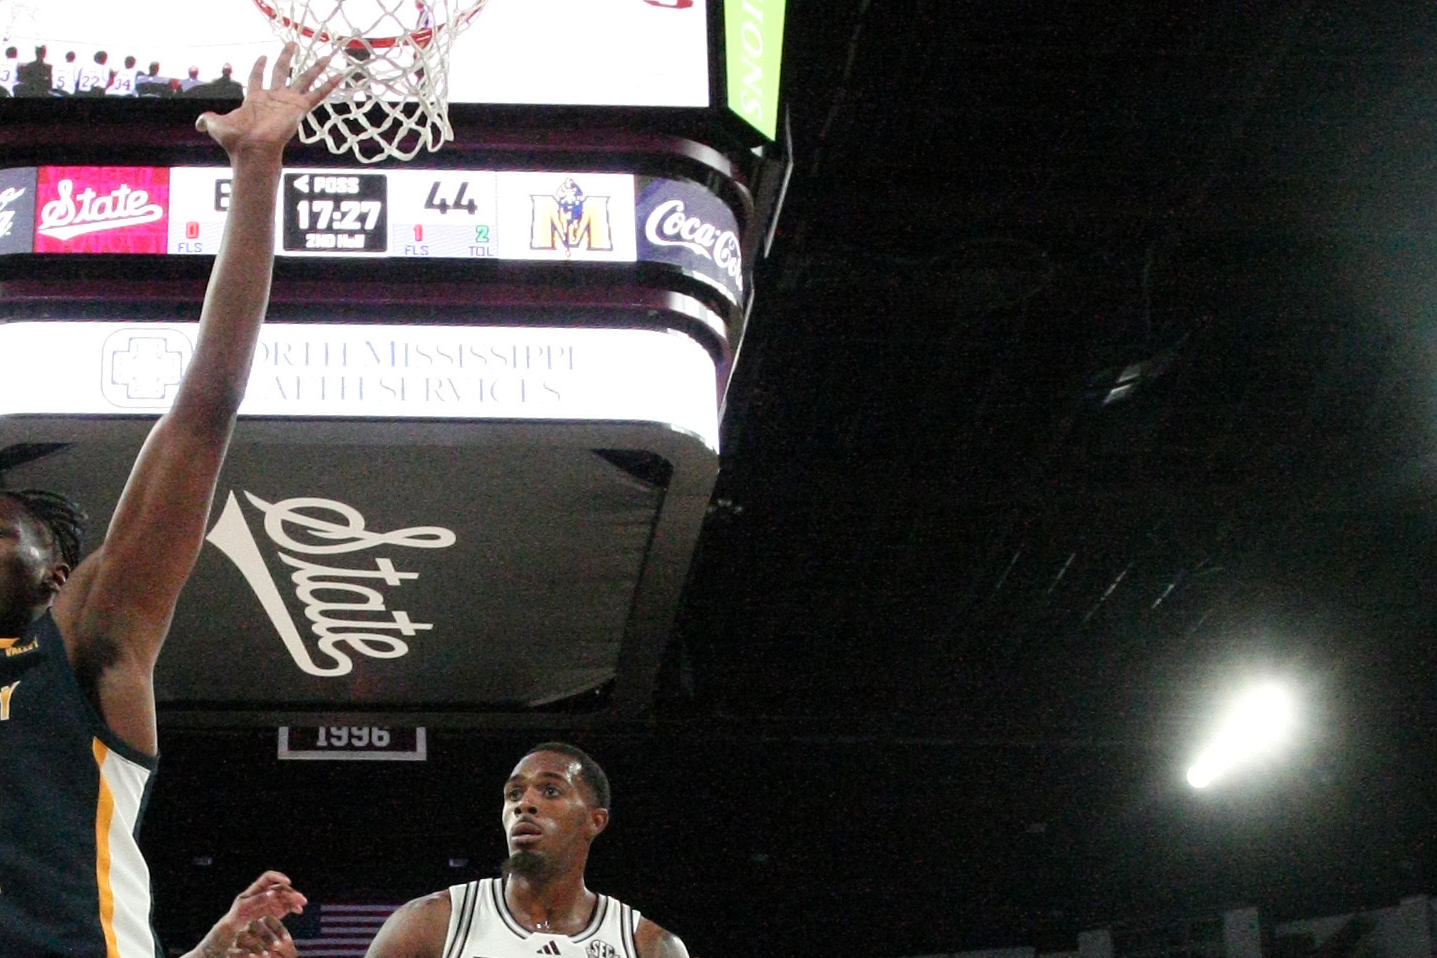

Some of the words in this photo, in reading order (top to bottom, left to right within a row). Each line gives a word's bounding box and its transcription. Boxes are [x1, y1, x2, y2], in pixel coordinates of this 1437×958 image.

[313, 176, 360, 194] POSS
[424, 181, 478, 215] 44
[38, 179, 164, 241] State
[297, 200, 382, 230] 17:27
[474, 224, 491, 244] 2
[177, 242, 203, 254] FLS
[404, 245, 430, 256] FLS
[468, 246, 494, 257] TOL
[207, 490, 456, 677] State
